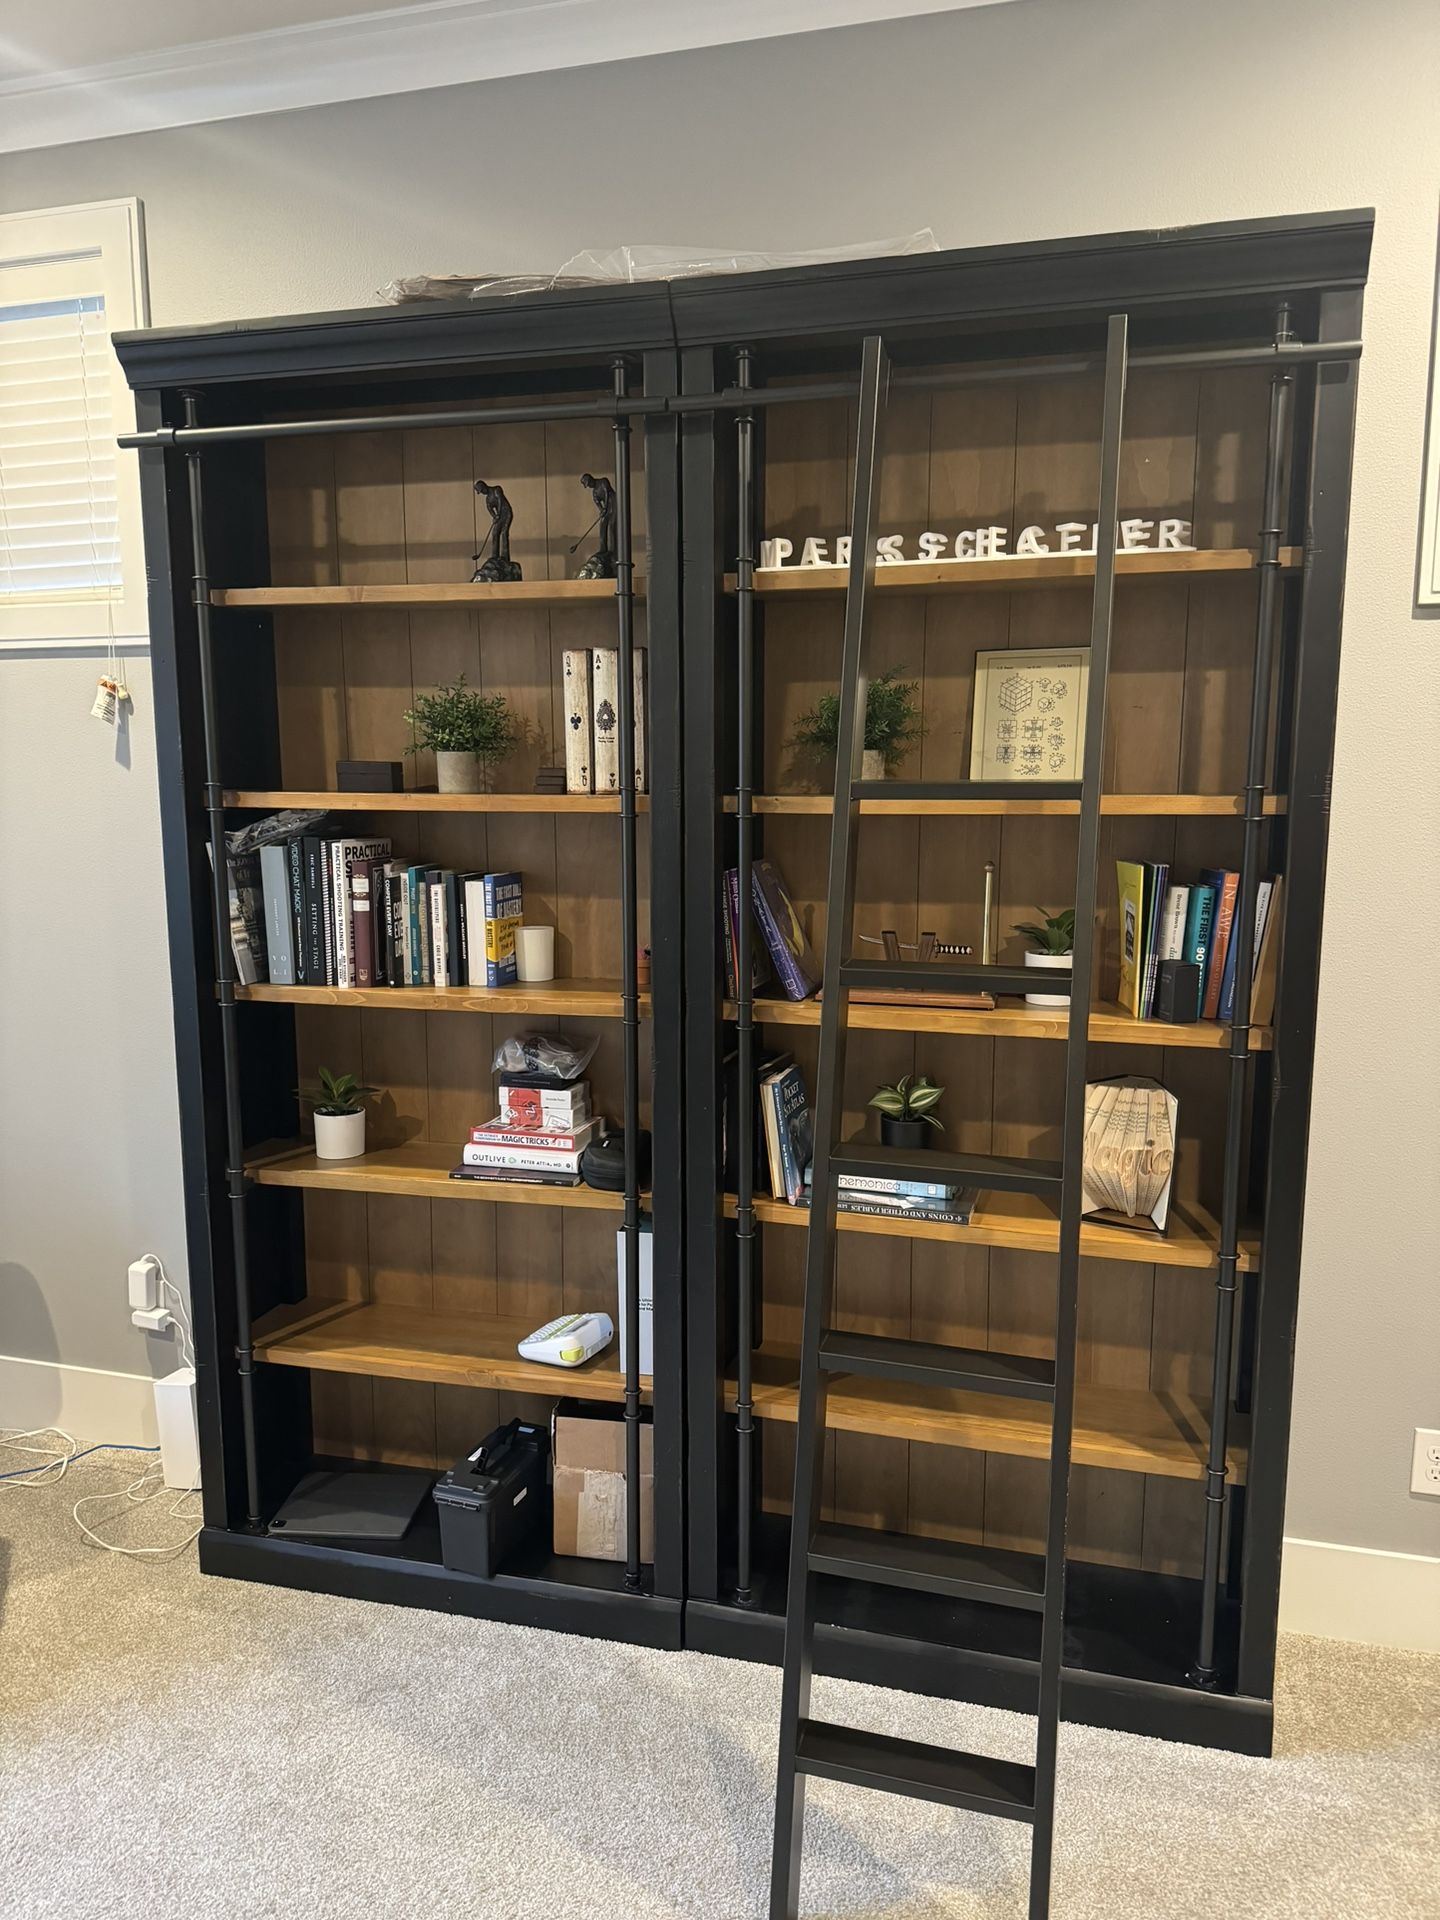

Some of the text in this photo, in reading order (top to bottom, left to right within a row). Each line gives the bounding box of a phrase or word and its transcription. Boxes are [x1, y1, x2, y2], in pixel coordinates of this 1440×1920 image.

[595, 654, 601, 664] A
[609, 778, 616, 788] A
[345, 843, 390, 860] PRACTICAL
[334, 845, 342, 880] PRACTICAL
[290, 842, 302, 913] VIDEO CHAT MAGIC
[1201, 896, 1212, 916] THE
[1216, 883, 1236, 939] IN AWE
[1198, 917, 1209, 946] FIRST
[1195, 947, 1206, 961] 90
[501, 1135, 524, 1145] MAGIC
[525, 1136, 550, 1146] TRICKS
[472, 1153, 506, 1164] OUTLIVE
[839, 1175, 901, 1192] nemonica
[851, 1205, 880, 1214] FABLES
[880, 1208, 909, 1217] OTHER
[909, 1211, 927, 1219] AND
[928, 1213, 954, 1222] COINS
